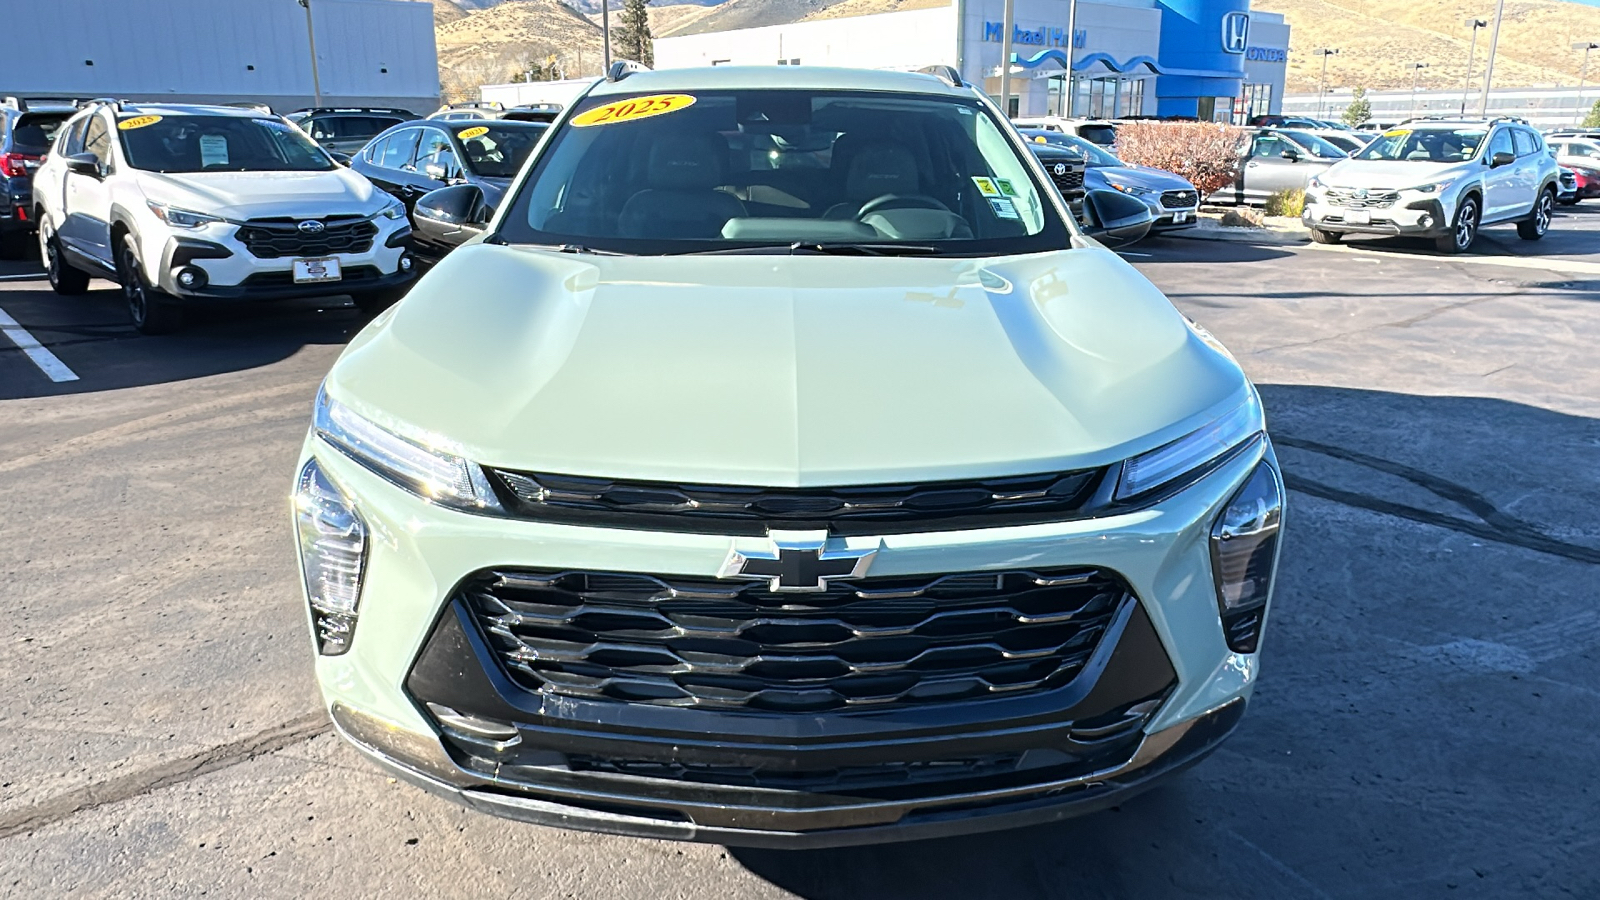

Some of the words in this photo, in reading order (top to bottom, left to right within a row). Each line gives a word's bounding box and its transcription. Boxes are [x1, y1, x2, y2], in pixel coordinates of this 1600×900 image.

[984, 21, 1046, 45] Mhael
[1246, 47, 1285, 62] ONDA
[592, 96, 675, 122] 2025
[126, 116, 154, 128] 2025
